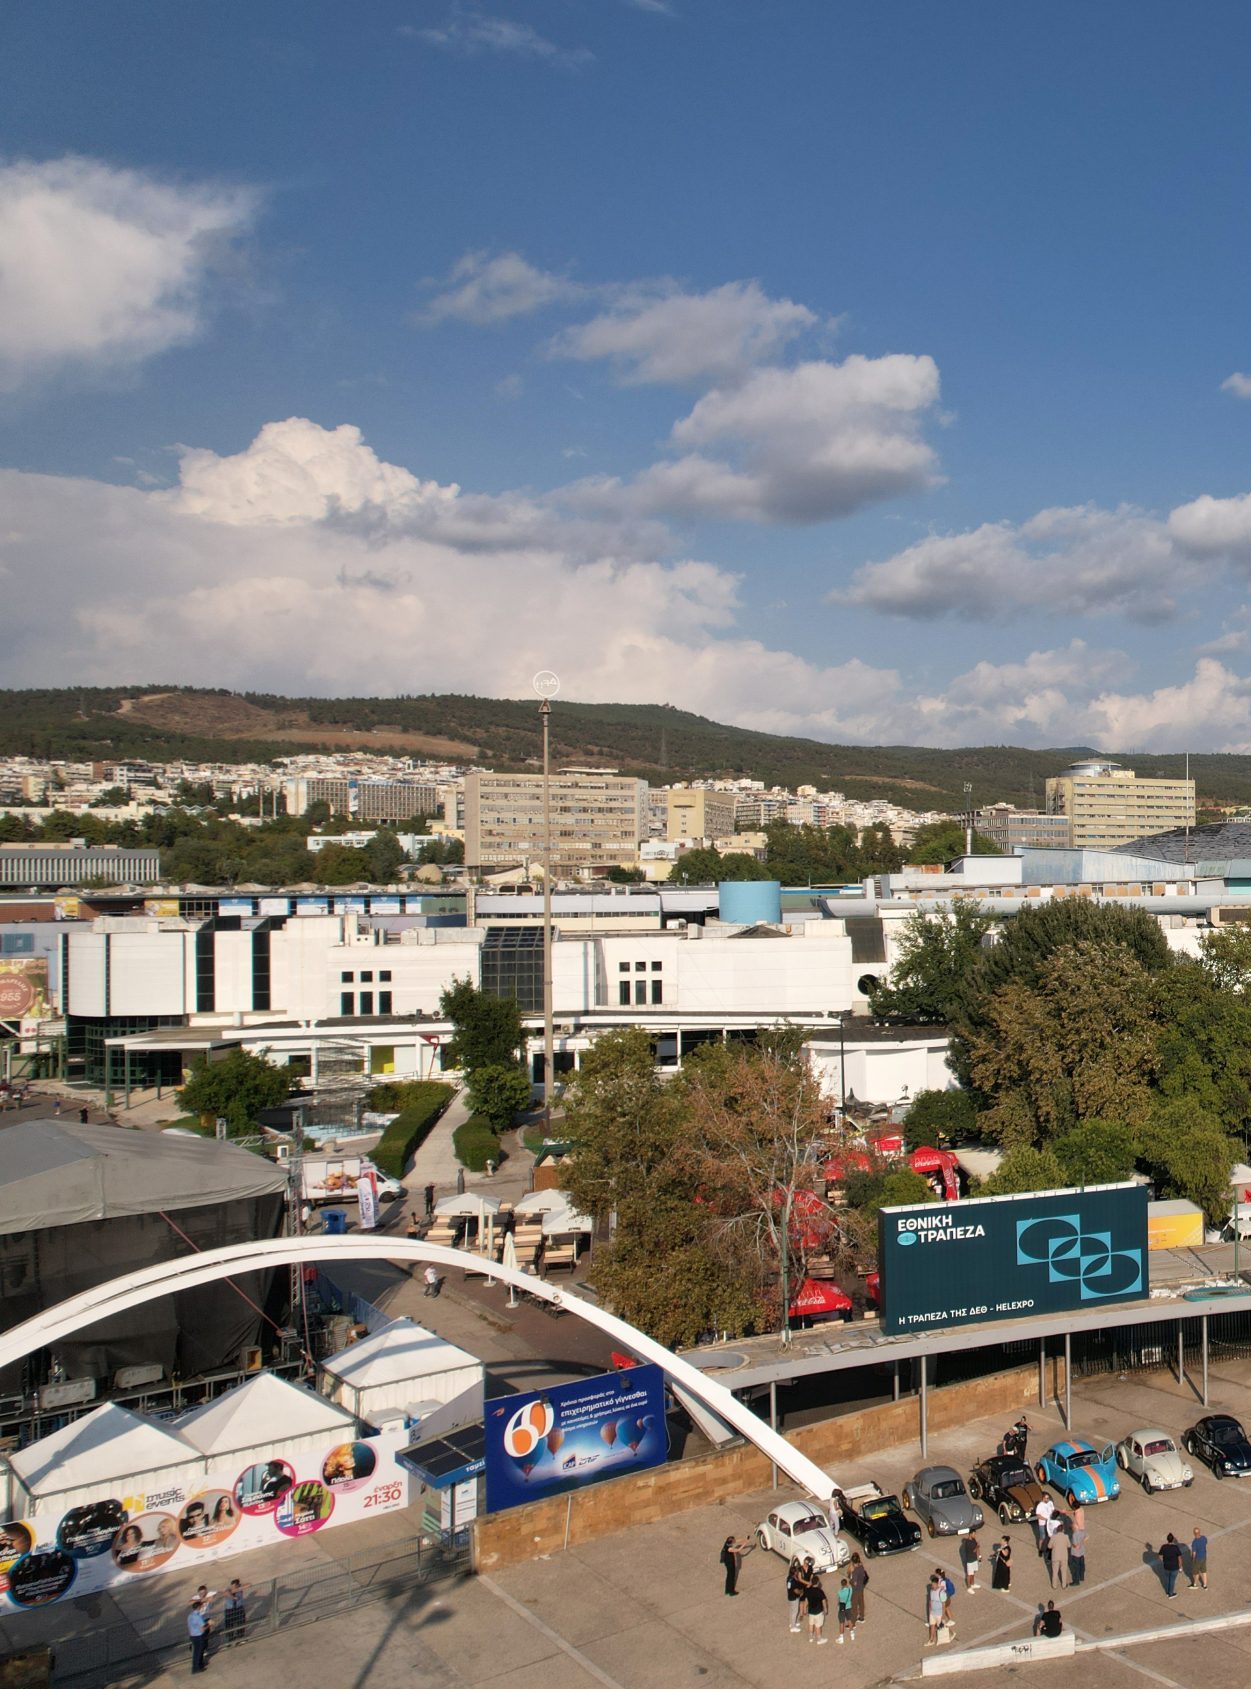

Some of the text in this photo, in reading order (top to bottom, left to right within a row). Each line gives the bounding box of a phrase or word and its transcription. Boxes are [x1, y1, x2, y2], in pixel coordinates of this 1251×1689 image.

[897, 1214, 953, 1232] ΕΘΝΙΚΗ
[918, 1224, 986, 1243] ΤΡΑΠΕΖΑ
[898, 1317, 906, 1325] Η
[908, 1311, 948, 1323] ΤΡΑΠΕΖΑ
[950, 1308, 967, 1318] ΤΗΣ
[969, 1305, 988, 1316] ΔΕΘ
[996, 1299, 1035, 1312] HELEXPO
[466, 1457, 486, 1473] ταμεί
[146, 1488, 183, 1503] music
[146, 1494, 186, 1510] events
[363, 1488, 402, 1509] 21:30
